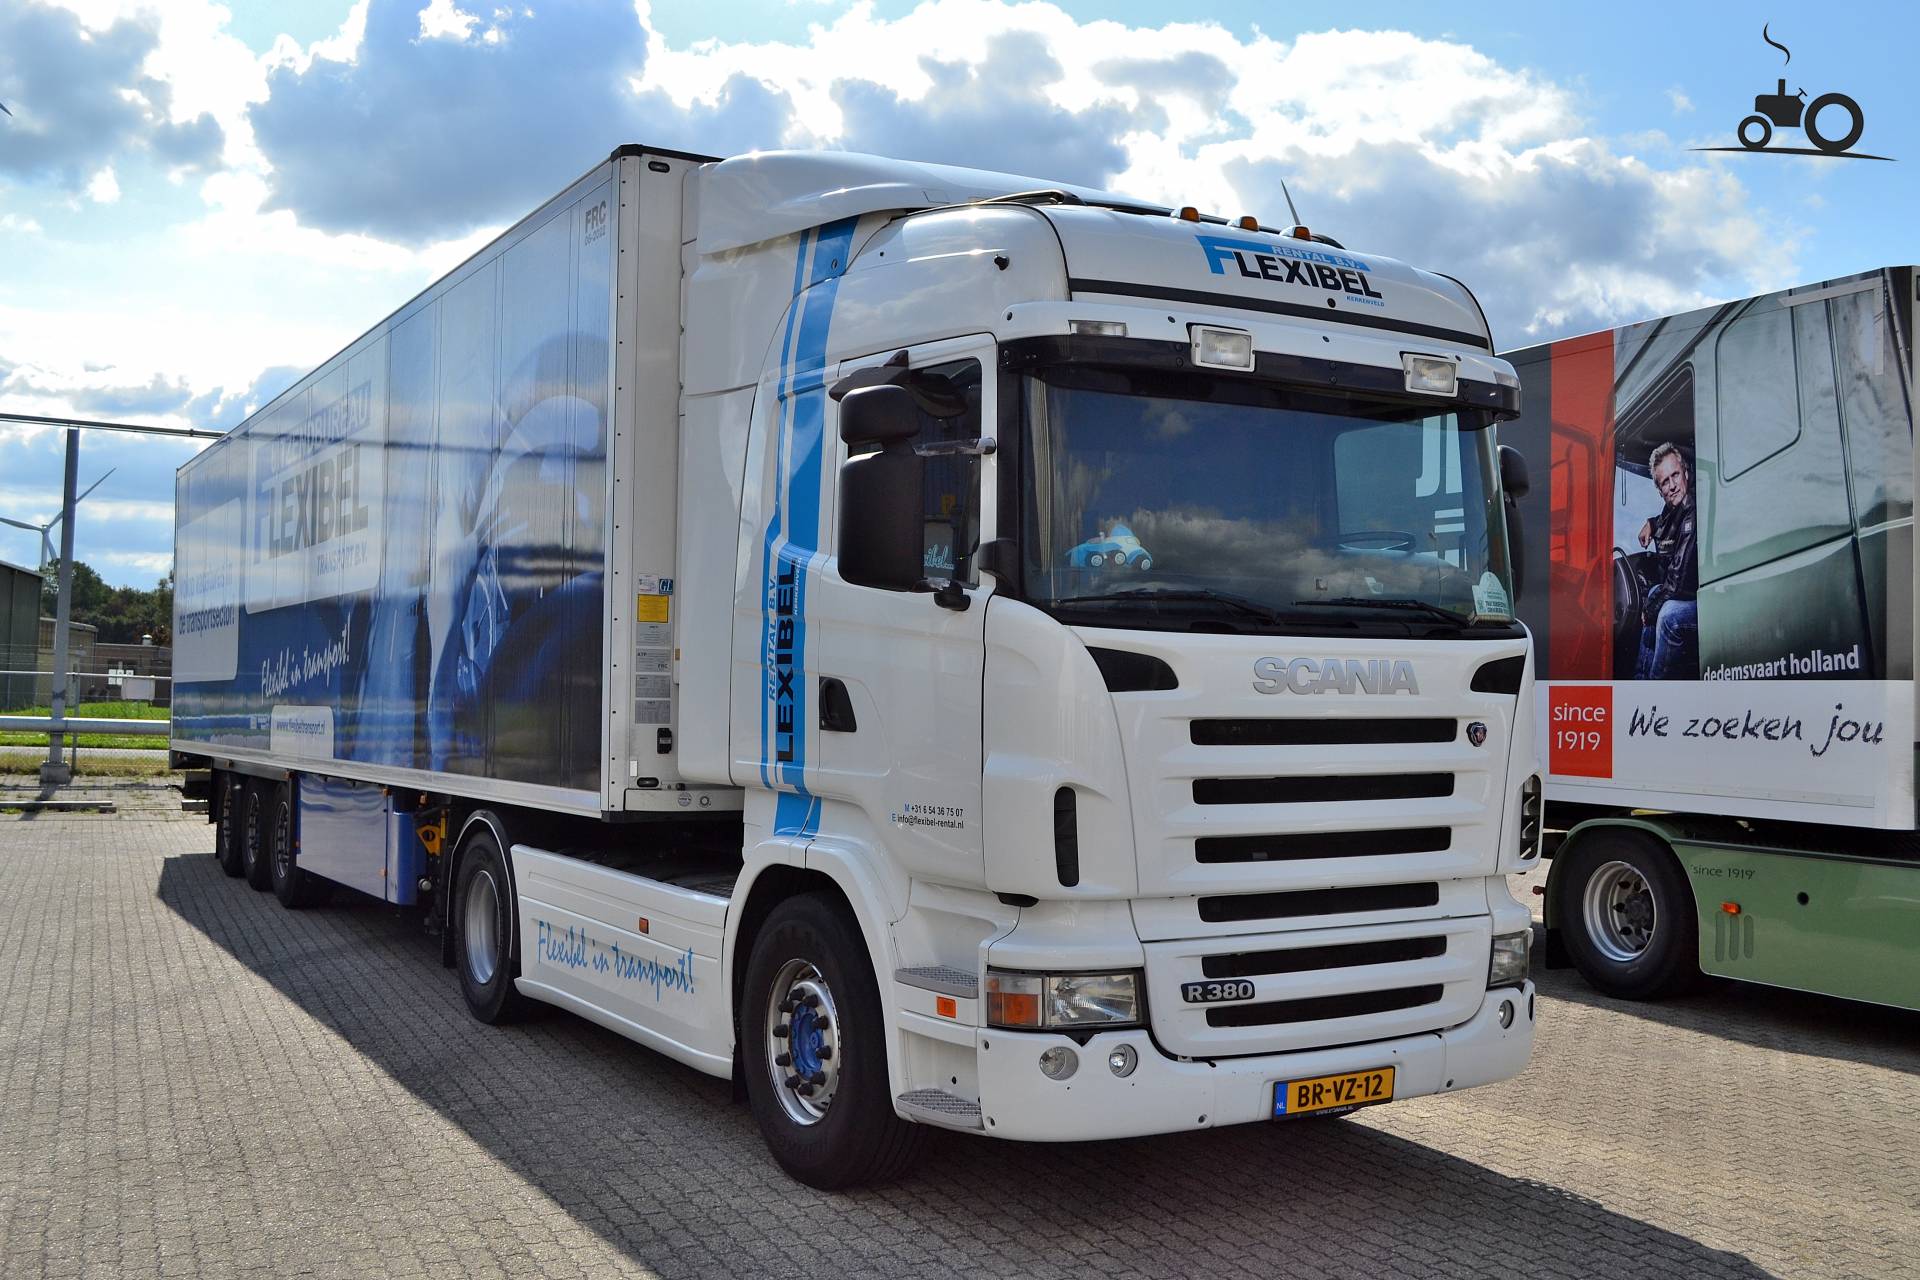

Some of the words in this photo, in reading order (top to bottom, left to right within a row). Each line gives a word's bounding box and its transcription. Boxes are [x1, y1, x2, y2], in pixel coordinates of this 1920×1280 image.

[585, 200, 606, 233] FRC
[1195, 235, 1383, 299] FLEXIBEL
[1271, 245, 1331, 265] RENTAL
[1334, 254, 1361, 269] B.V.
[1346, 295, 1385, 307] KERKENVELD
[254, 442, 369, 564] FLEXIBEL
[768, 620, 777, 701] RENTAL
[1252, 656, 1420, 695] SCANIA
[1703, 657, 1787, 681] dedemsvaart
[1789, 645, 1860, 675] holland
[1553, 703, 1606, 722] since
[1628, 705, 1669, 738] We
[1682, 709, 1802, 741] zoeken
[1810, 703, 1884, 757] jou
[1556, 730, 1601, 751] 1919
[897, 814, 964, 829] info@flexibel-rental.nl
[955, 808, 964, 817] 07
[538, 920, 588, 968] Flexibel
[592, 939, 610, 975] in
[611, 940, 695, 1002] transport!
[1276, 1101, 1286, 1110] NL
[1297, 1074, 1383, 1108] BR-VZ-12
